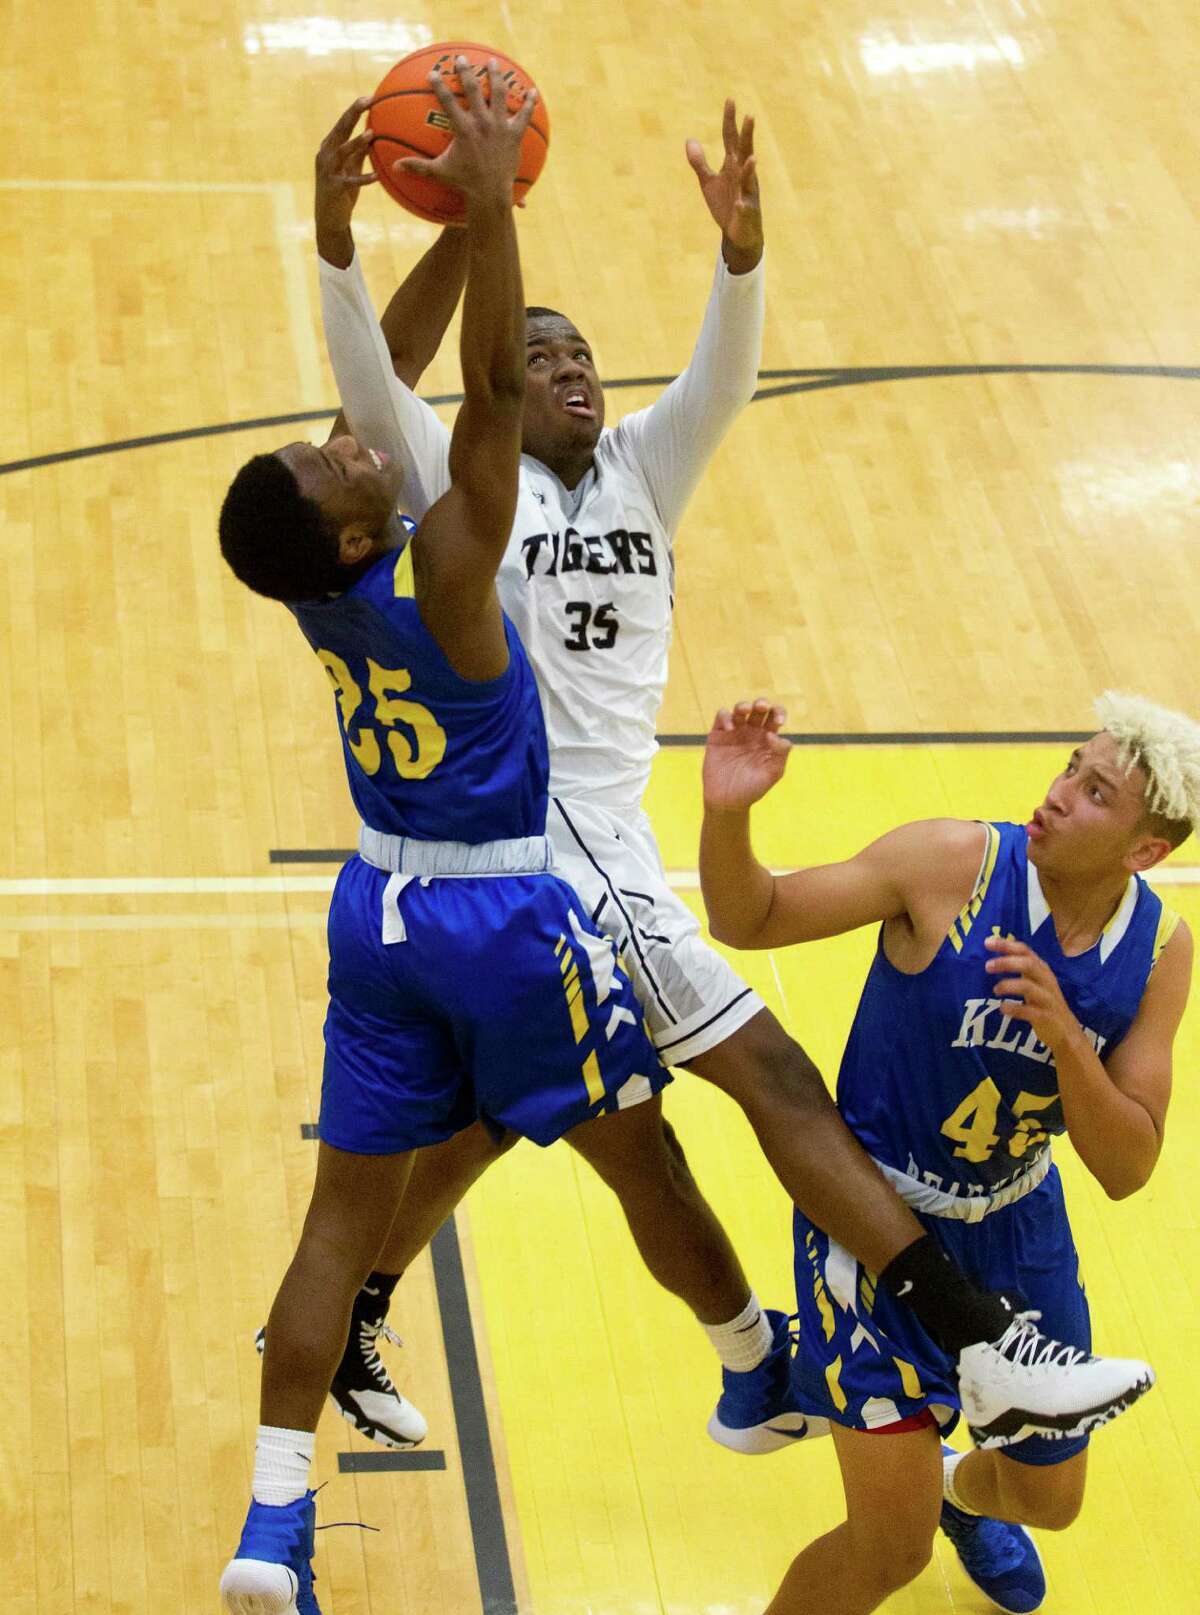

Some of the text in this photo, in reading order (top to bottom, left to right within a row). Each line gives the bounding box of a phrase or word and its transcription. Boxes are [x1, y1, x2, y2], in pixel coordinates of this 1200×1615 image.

[521, 527, 657, 582] TIGERS
[564, 601, 619, 651] 35
[317, 648, 447, 780] 25
[940, 1076, 1060, 1163] 45
